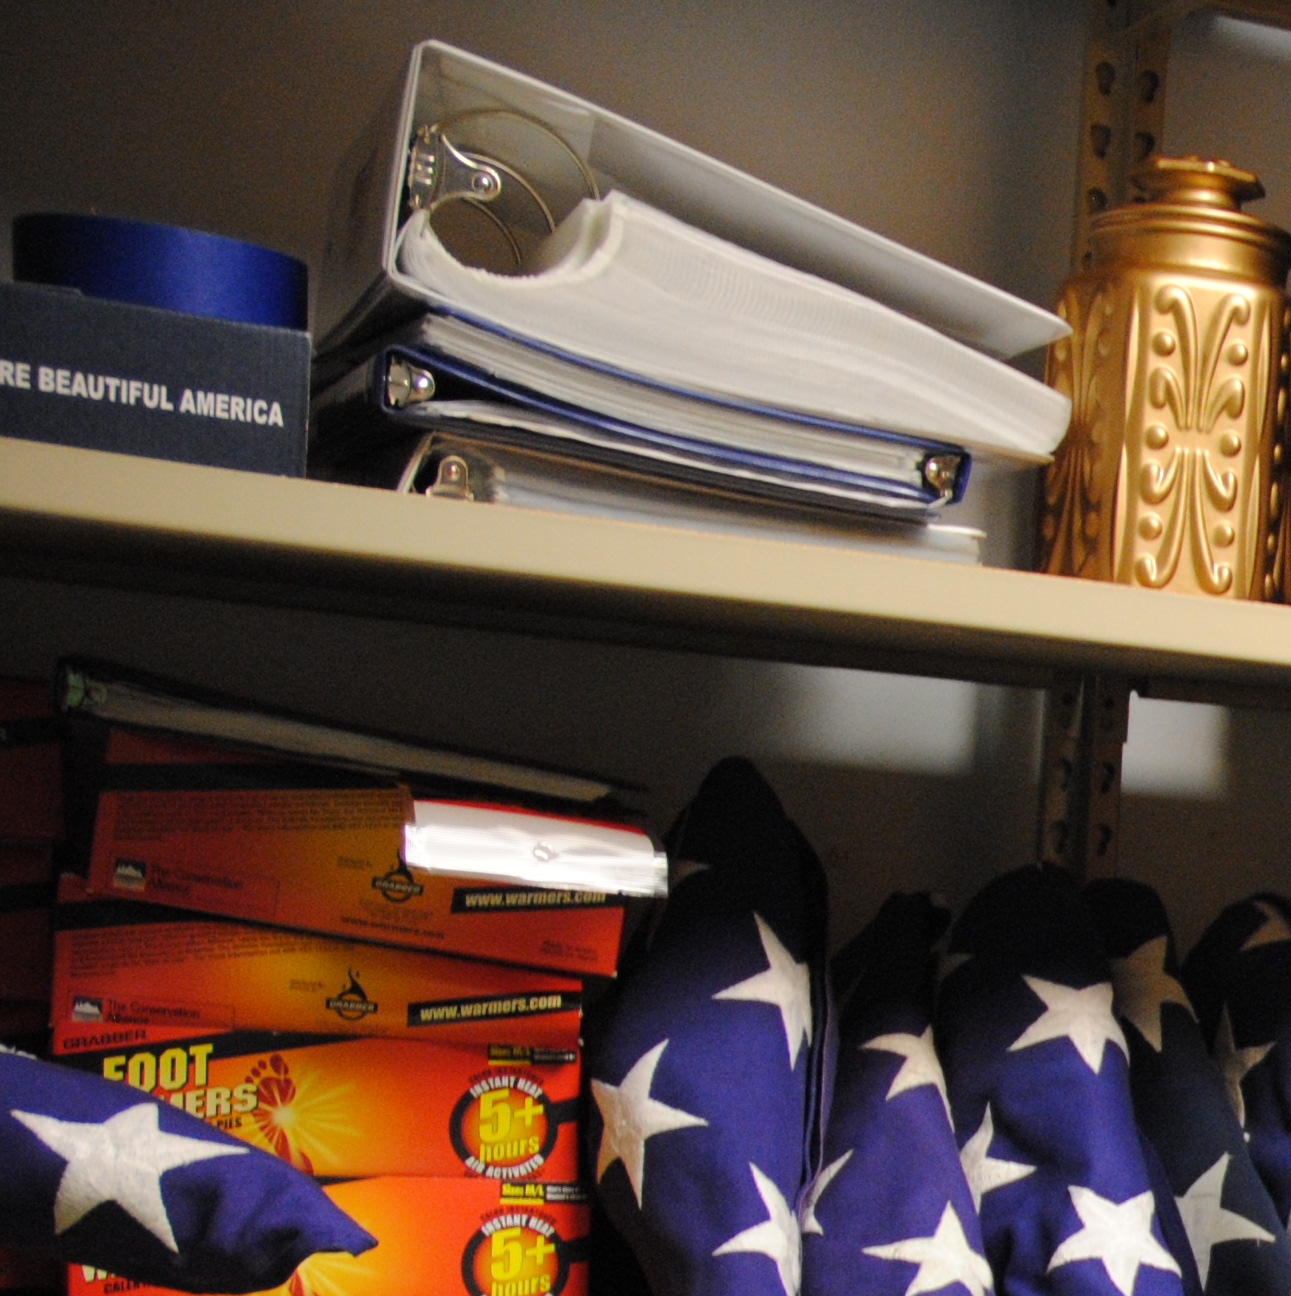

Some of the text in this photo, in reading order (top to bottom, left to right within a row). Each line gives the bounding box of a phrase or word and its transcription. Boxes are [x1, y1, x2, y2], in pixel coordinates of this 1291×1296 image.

[38, 366, 174, 411] BEAUTIFUL
[180, 389, 284, 427] AMERICA
[465, 891, 606, 907] www.warmers.com
[420, 994, 562, 1021] www.warmers.com
[63, 1029, 146, 1049] GRABBER
[103, 1043, 214, 1093] FOOT
[479, 1088, 544, 1143] 5+
[479, 1136, 540, 1163] hours
[486, 1154, 544, 1179] ACTIVATED
[481, 1214, 555, 1237] INSTANT HEAT
[491, 1227, 555, 1281] 5+
